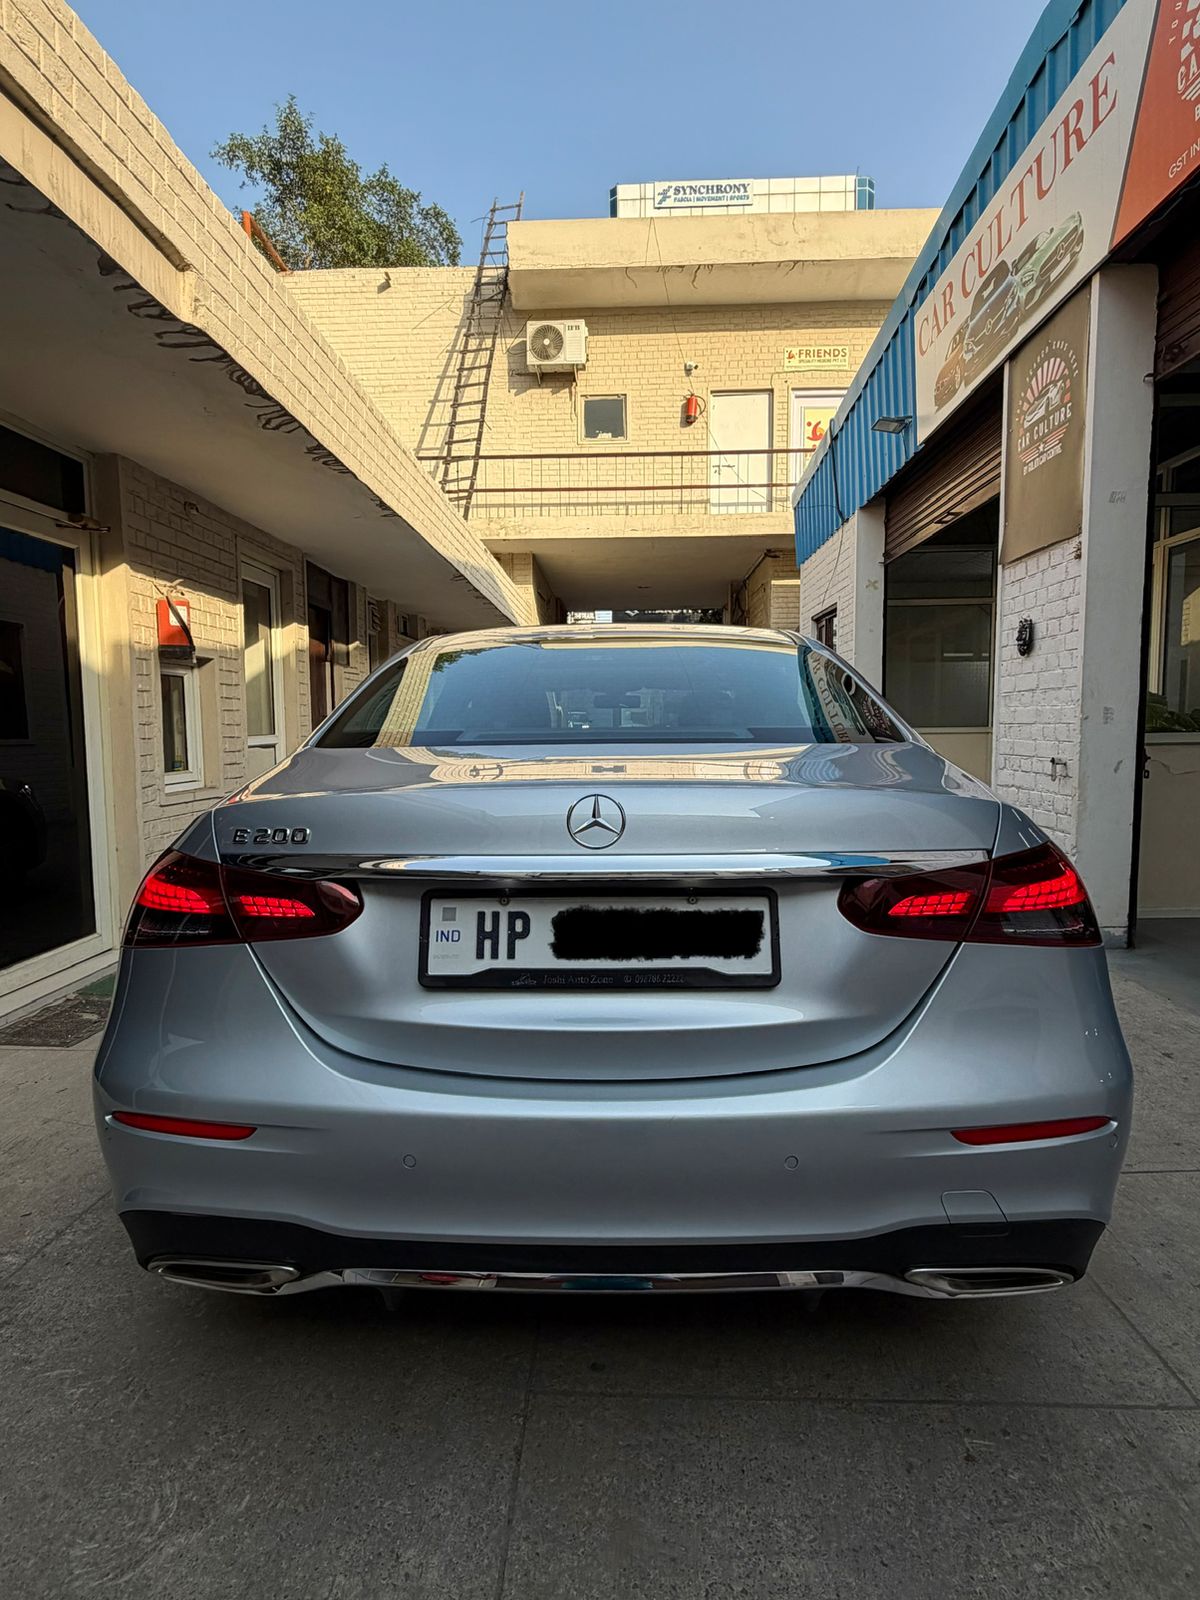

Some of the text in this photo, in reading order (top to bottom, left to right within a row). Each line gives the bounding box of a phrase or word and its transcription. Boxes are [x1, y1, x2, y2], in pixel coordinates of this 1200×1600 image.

[1168, 150, 1189, 178] GST
[673, 183, 750, 196] SYNCHRONY
[918, 51, 1118, 357] CAR CULTURE
[798, 348, 847, 358] FRIENDS
[1017, 402, 1072, 452] CAR CULTURE
[232, 827, 311, 844] E 200
[435, 929, 461, 942] IND
[476, 911, 531, 960] HP
